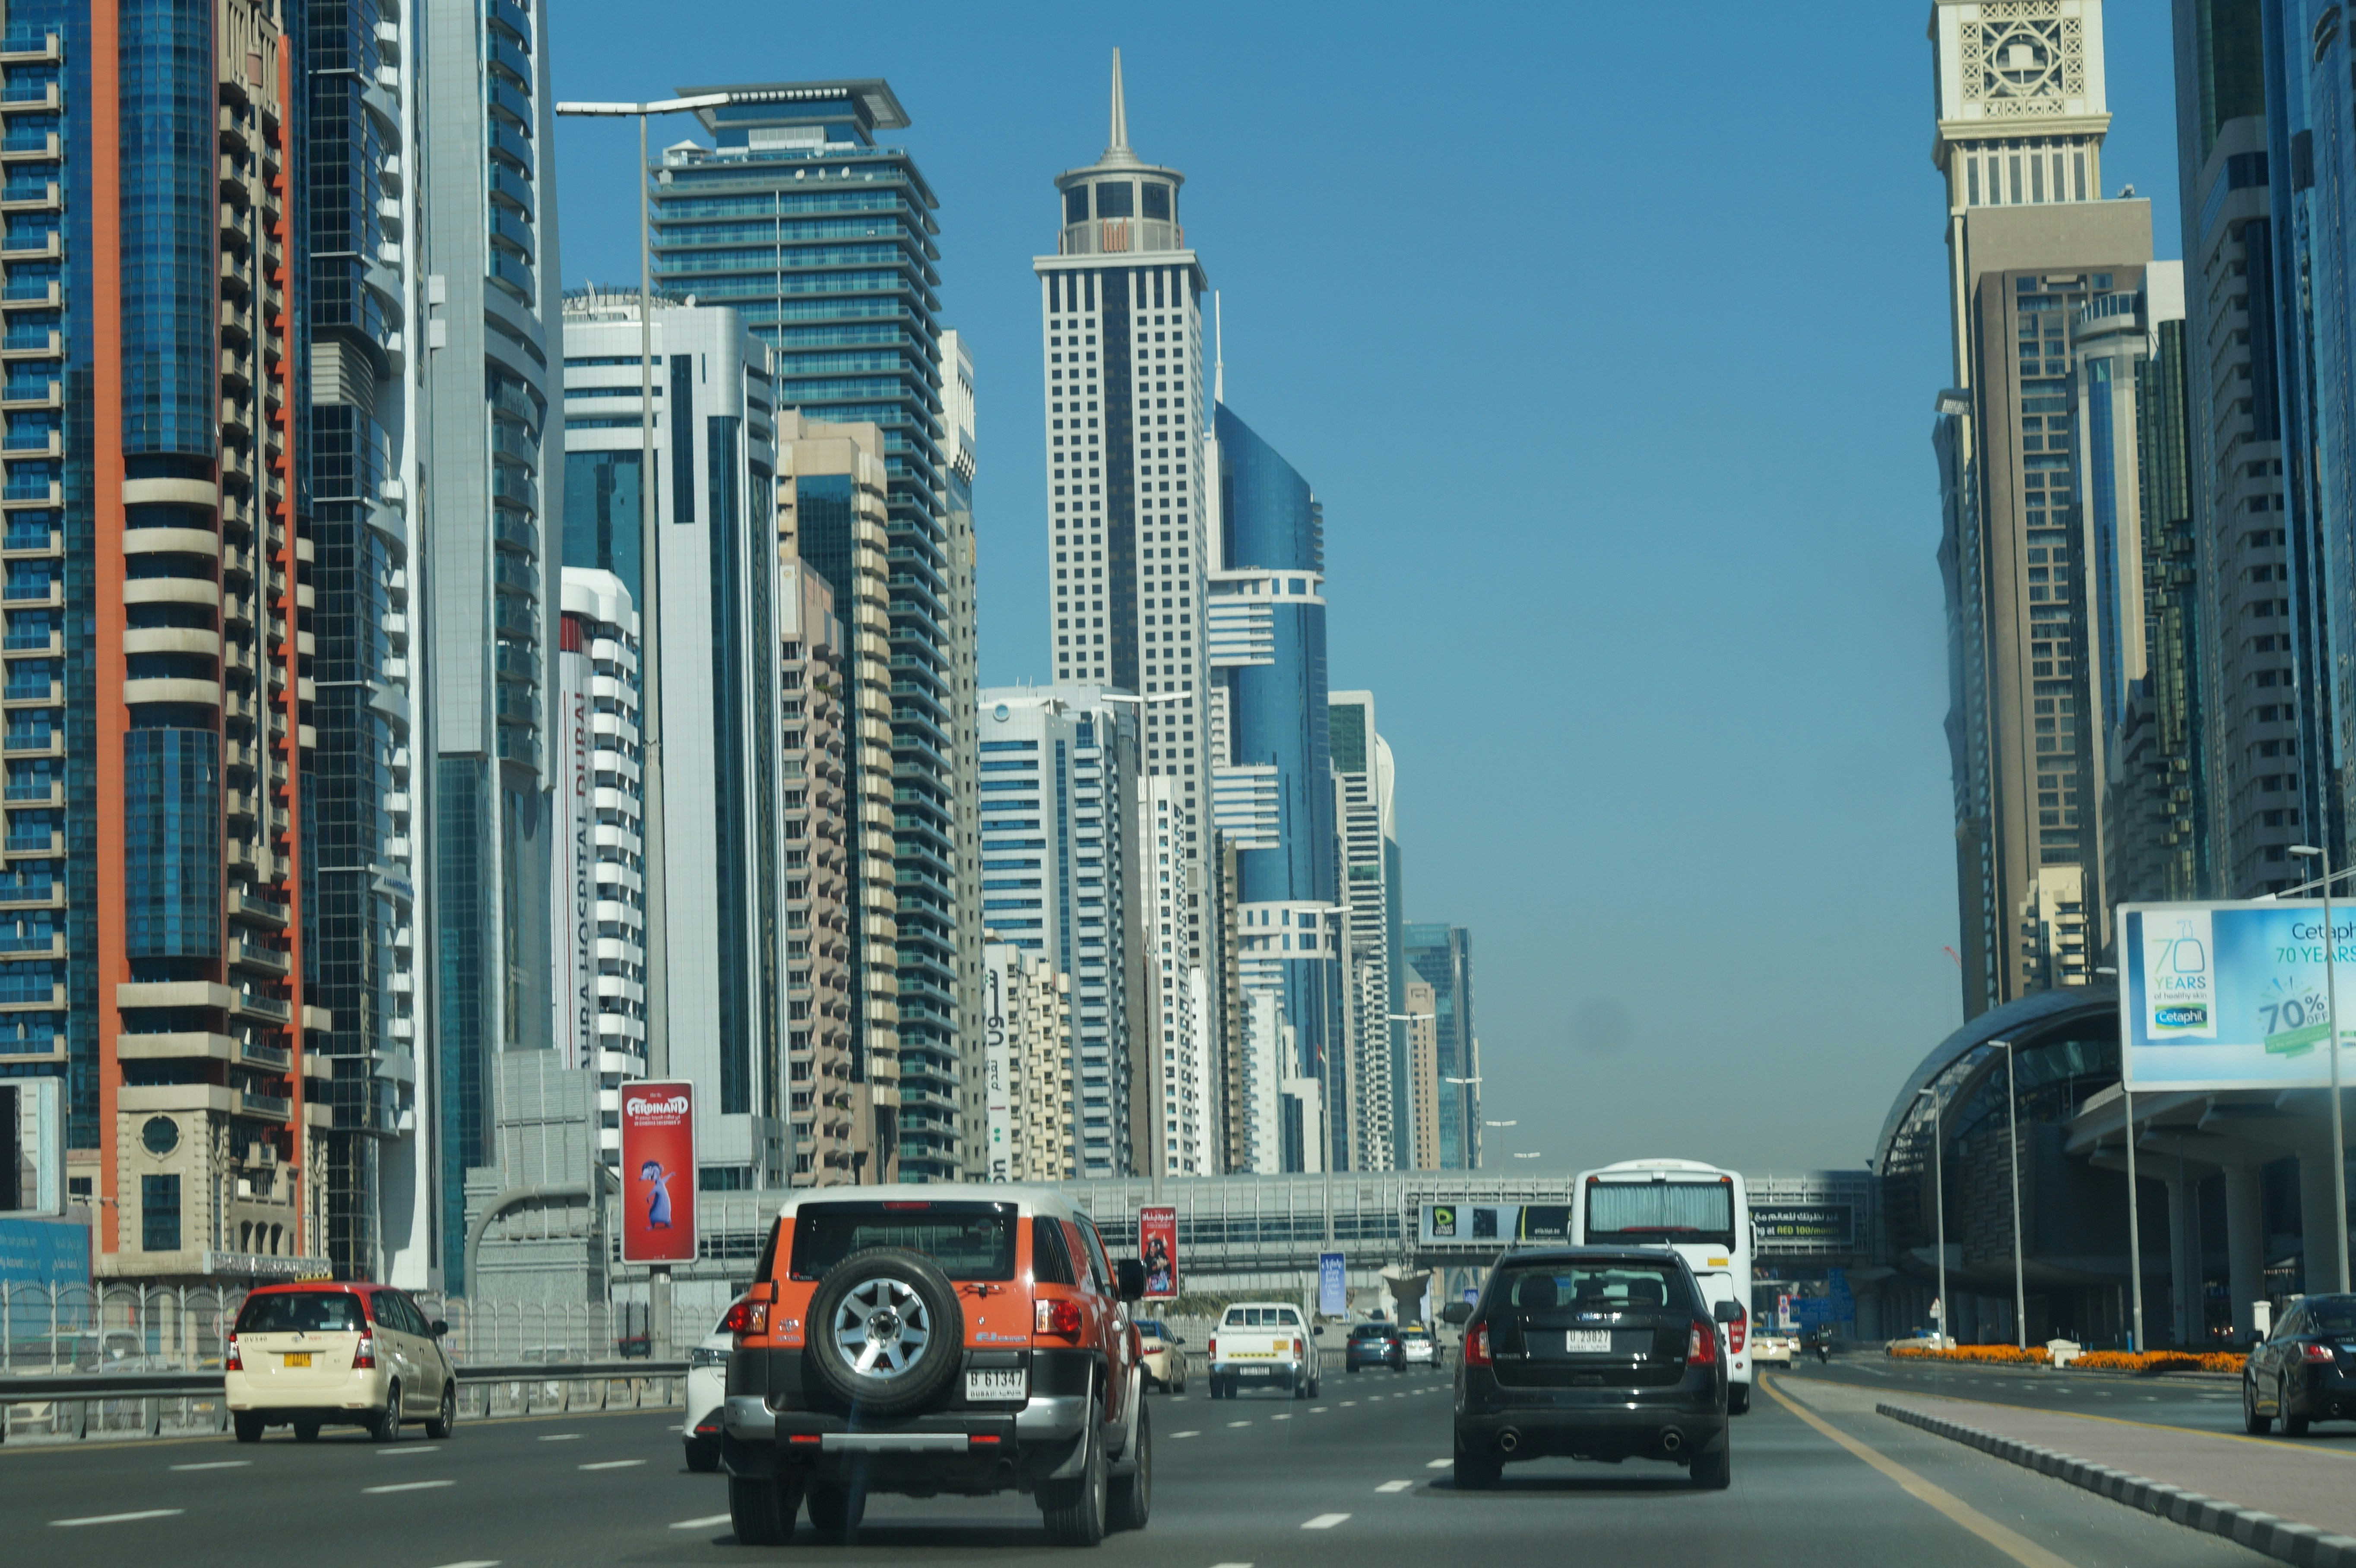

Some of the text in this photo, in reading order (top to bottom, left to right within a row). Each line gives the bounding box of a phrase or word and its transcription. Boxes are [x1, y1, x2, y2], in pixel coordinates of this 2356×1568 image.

[575, 692, 586, 797] DUBAI
[576, 809, 589, 971] HOSPITAL
[2276, 945, 2356, 963] 70 YEARS
[2154, 976, 2206, 989] YEARS
[2164, 992, 2191, 1001] healthy
[2159, 1010, 2203, 1024] Cetaphil
[2307, 1011, 2328, 1024] OFF
[627, 1096, 688, 1117] FERDINAND
[1767, 1226, 1775, 1235] at
[1777, 1225, 1793, 1235] AED
[971, 1370, 1022, 1387] B 61347
